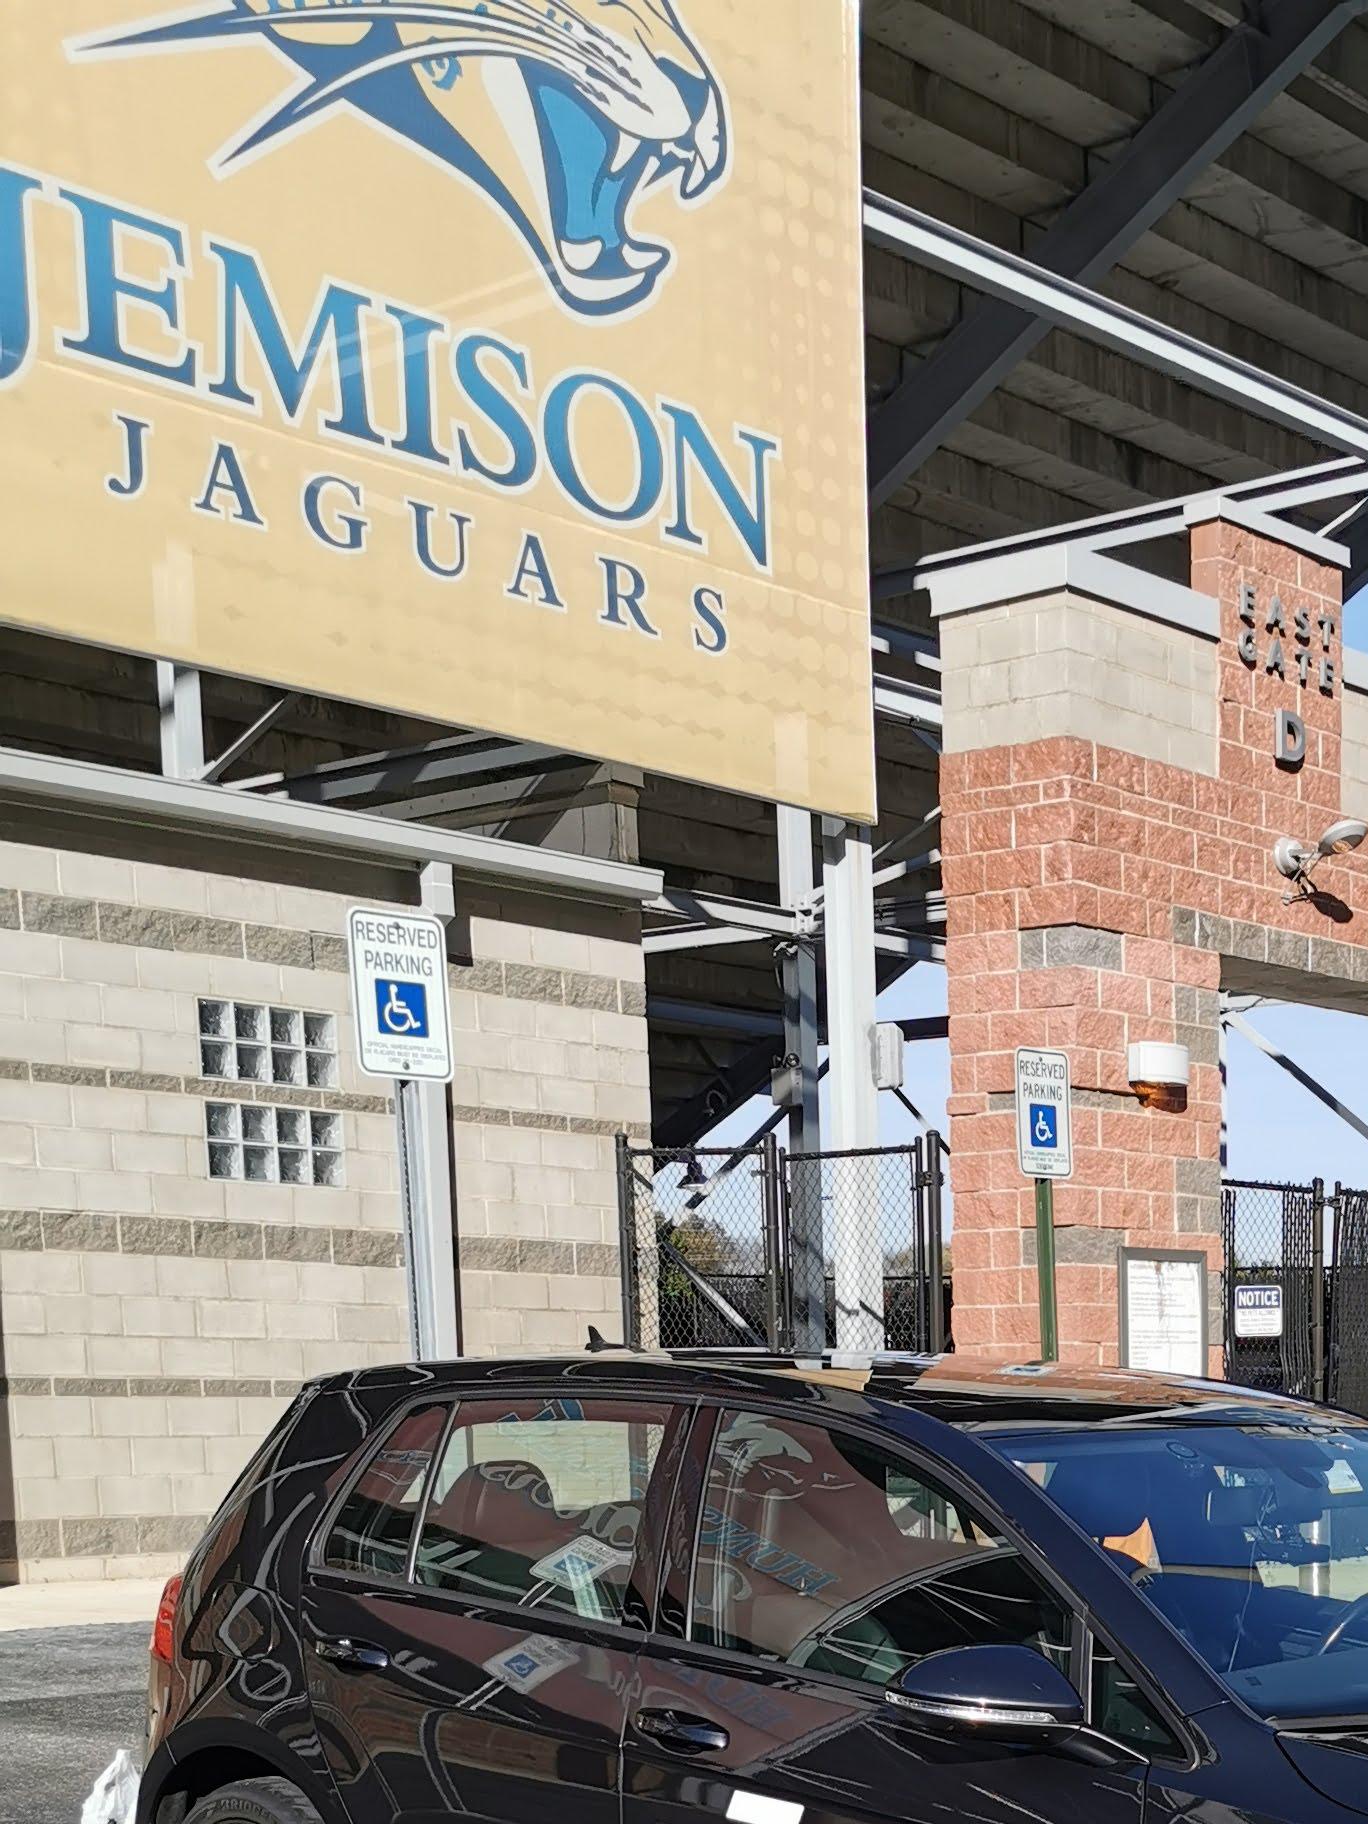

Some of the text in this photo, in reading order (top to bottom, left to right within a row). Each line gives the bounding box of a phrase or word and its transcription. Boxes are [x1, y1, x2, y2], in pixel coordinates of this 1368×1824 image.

[107, 414, 730, 655] JAGUARS
[1238, 583, 1335, 650] EAST
[1237, 628, 1335, 696] GATE
[1275, 707, 1306, 768] D
[354, 919, 438, 950] RESERVED
[364, 949, 433, 977] PARKING
[1020, 1060, 1065, 1080] RESERVED
[1023, 1082, 1063, 1101] PARKING
[1238, 1290, 1279, 1307] NOTICE
